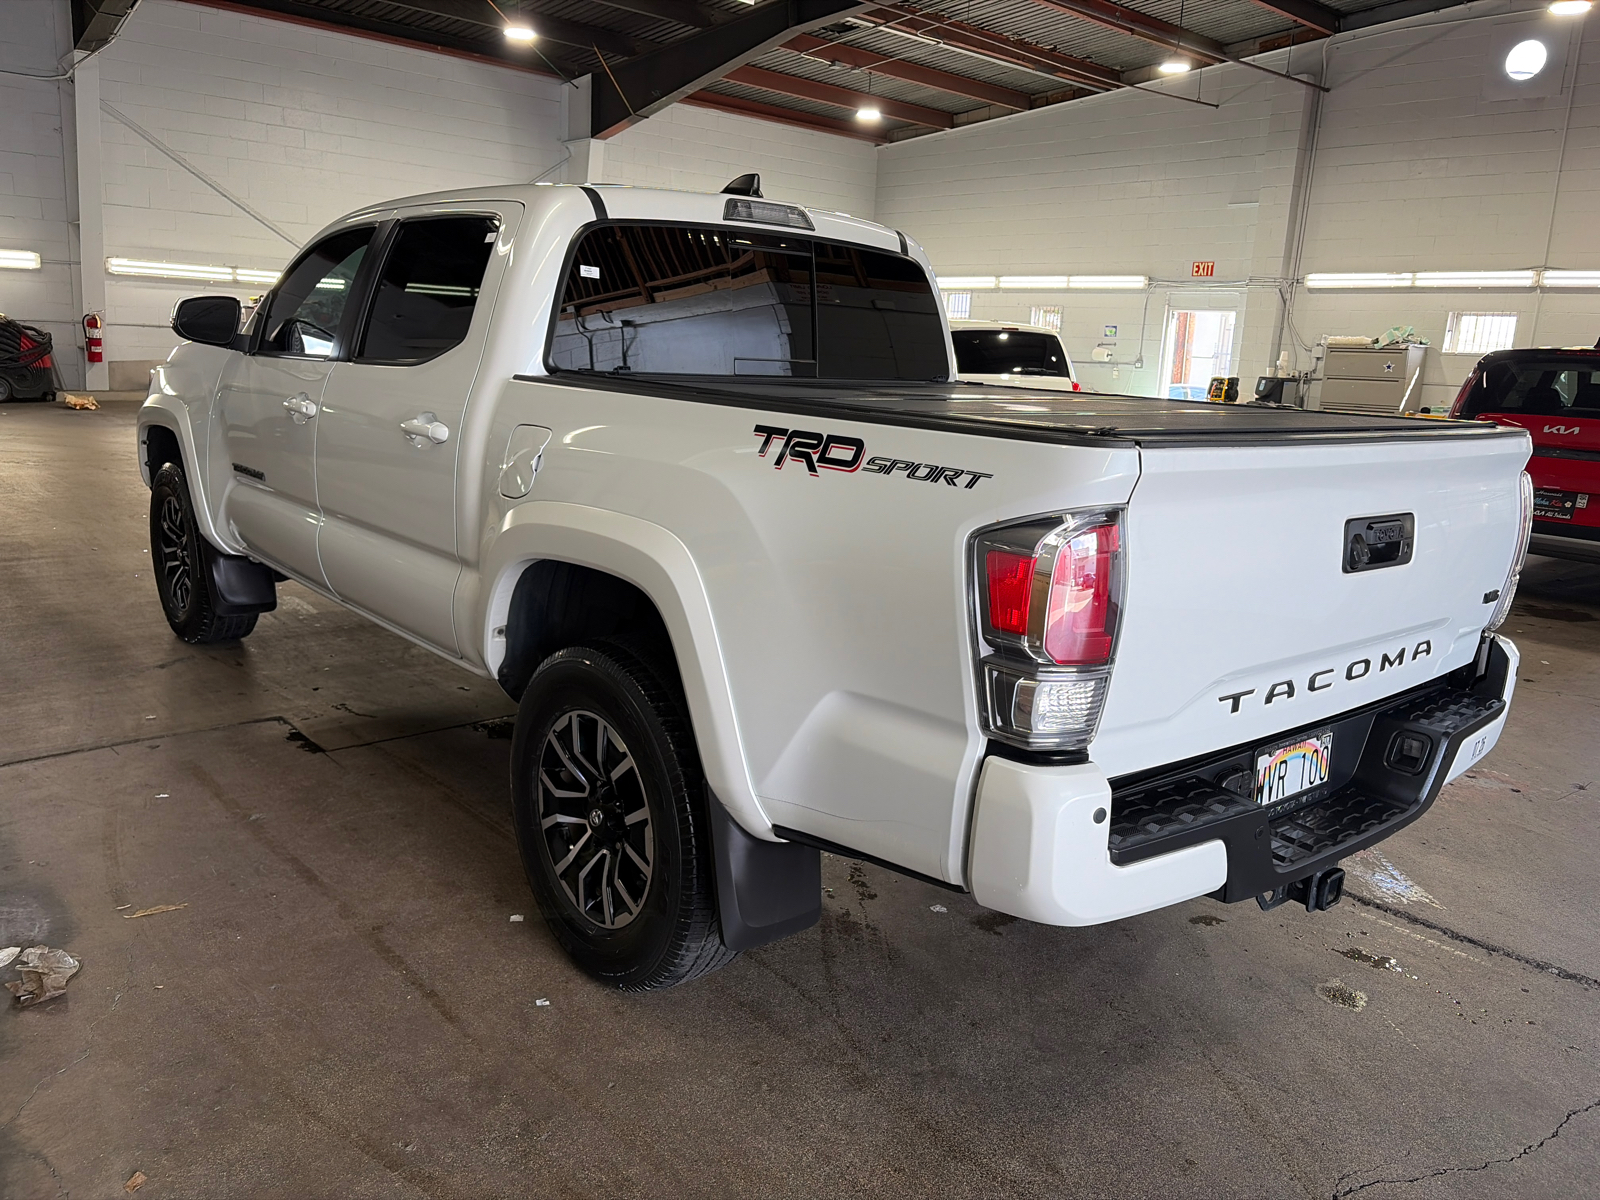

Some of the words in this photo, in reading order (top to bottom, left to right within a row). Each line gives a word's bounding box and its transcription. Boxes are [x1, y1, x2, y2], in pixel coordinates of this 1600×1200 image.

[1192, 262, 1214, 276] EXIT
[753, 424, 867, 477] TRD
[861, 456, 994, 490] SPORT
[1543, 424, 1580, 435] KIA
[1218, 639, 1432, 714] TACOMA
[1256, 760, 1288, 804] WVR
[1300, 746, 1329, 789] 100
